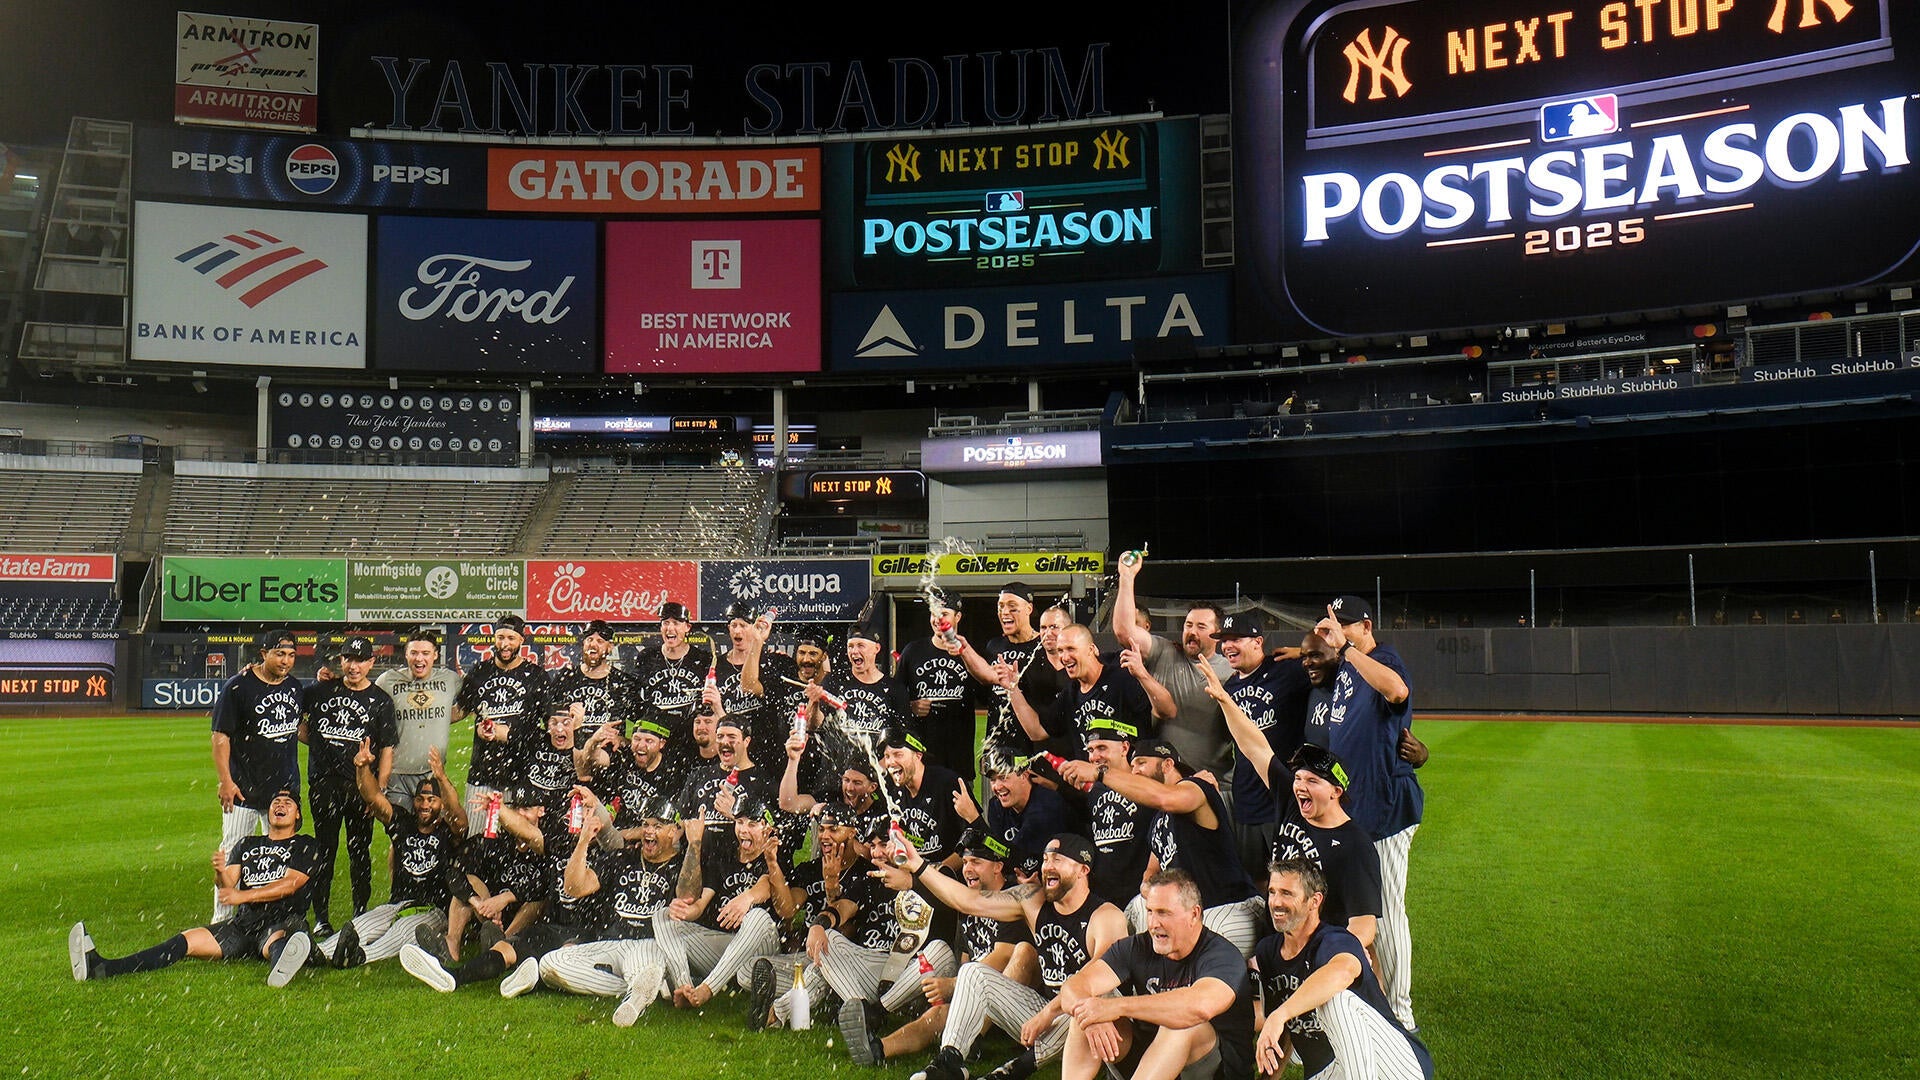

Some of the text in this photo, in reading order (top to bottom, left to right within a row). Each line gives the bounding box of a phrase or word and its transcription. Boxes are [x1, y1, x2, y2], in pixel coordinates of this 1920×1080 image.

[183, 24, 311, 50] ARMITRON
[1447, 11, 1574, 75] NEXT
[1600, 0, 1735, 49] STOP
[371, 42, 1111, 137] YANKEE STADIUM
[189, 90, 303, 112] ARMITRON
[244, 108, 300, 122] WATCHES
[172, 151, 253, 174] PEPSI
[939, 140, 1079, 173] NEXT STOP
[288, 162, 337, 177] PEPSI
[372, 164, 449, 186] PEPSI
[1302, 96, 1911, 242] POSTSEASON
[508, 158, 803, 201] GATORADE
[864, 207, 1152, 256] POSTSEASON
[1523, 219, 1646, 256] 2025
[976, 253, 1036, 270] 2025
[399, 253, 575, 325] Ford
[641, 312, 791, 330] BEST NETWORK
[943, 293, 1204, 350] DELTA
[137, 323, 360, 347] BANK OF AMERICA
[659, 332, 773, 349] IN AMERICA
[1528, 340, 1574, 352] Mastercard
[1754, 366, 1816, 382] StubHub
[1830, 358, 1895, 376] StubHub
[1502, 388, 1555, 402] StubHub
[1561, 382, 1616, 398] StubHub
[1621, 378, 1678, 394] StubHub
[346, 414, 447, 434] New York Yankees
[605, 420, 653, 430] POSTSEASON
[675, 420, 707, 429] NEXT STOP
[963, 444, 1066, 463] POSTSEASON
[813, 480, 840, 493] NEXT
[844, 480, 871, 493] STOP
[42, 558, 90, 577] Farm
[354, 562, 422, 579] Morningside
[460, 562, 519, 577] Workmen's
[956, 557, 1019, 574] Gillette
[1034, 555, 1100, 573] Gillette
[170, 575, 339, 603] Uber Eats
[384, 586, 407, 595] Nursing
[486, 577, 518, 591] Circle
[766, 573, 841, 599] coupa
[354, 593, 397, 601] Rehabilitation
[799, 602, 841, 616] Multiply
[916, 657, 969, 682] OCTOBER
[1, 680, 37, 693] NEXT
[44, 680, 80, 693] STOP
[393, 680, 447, 697] BREAKING
[477, 676, 526, 698] OCTOBER
[916, 681, 965, 698] Baseball
[415, 694, 427, 704] 42
[480, 700, 524, 716] Baseball
[320, 696, 370, 725] OCTOBER
[396, 706, 445, 721] BARRIERS
[317, 717, 366, 741] Baseball
[1092, 790, 1138, 817] OCTOBER
[242, 845, 292, 862] OCTOBER
[243, 865, 288, 883] Baseball
[619, 870, 670, 893] OCTOBER
[615, 892, 667, 915] Baseball
[1034, 923, 1087, 965] OCTOBER
